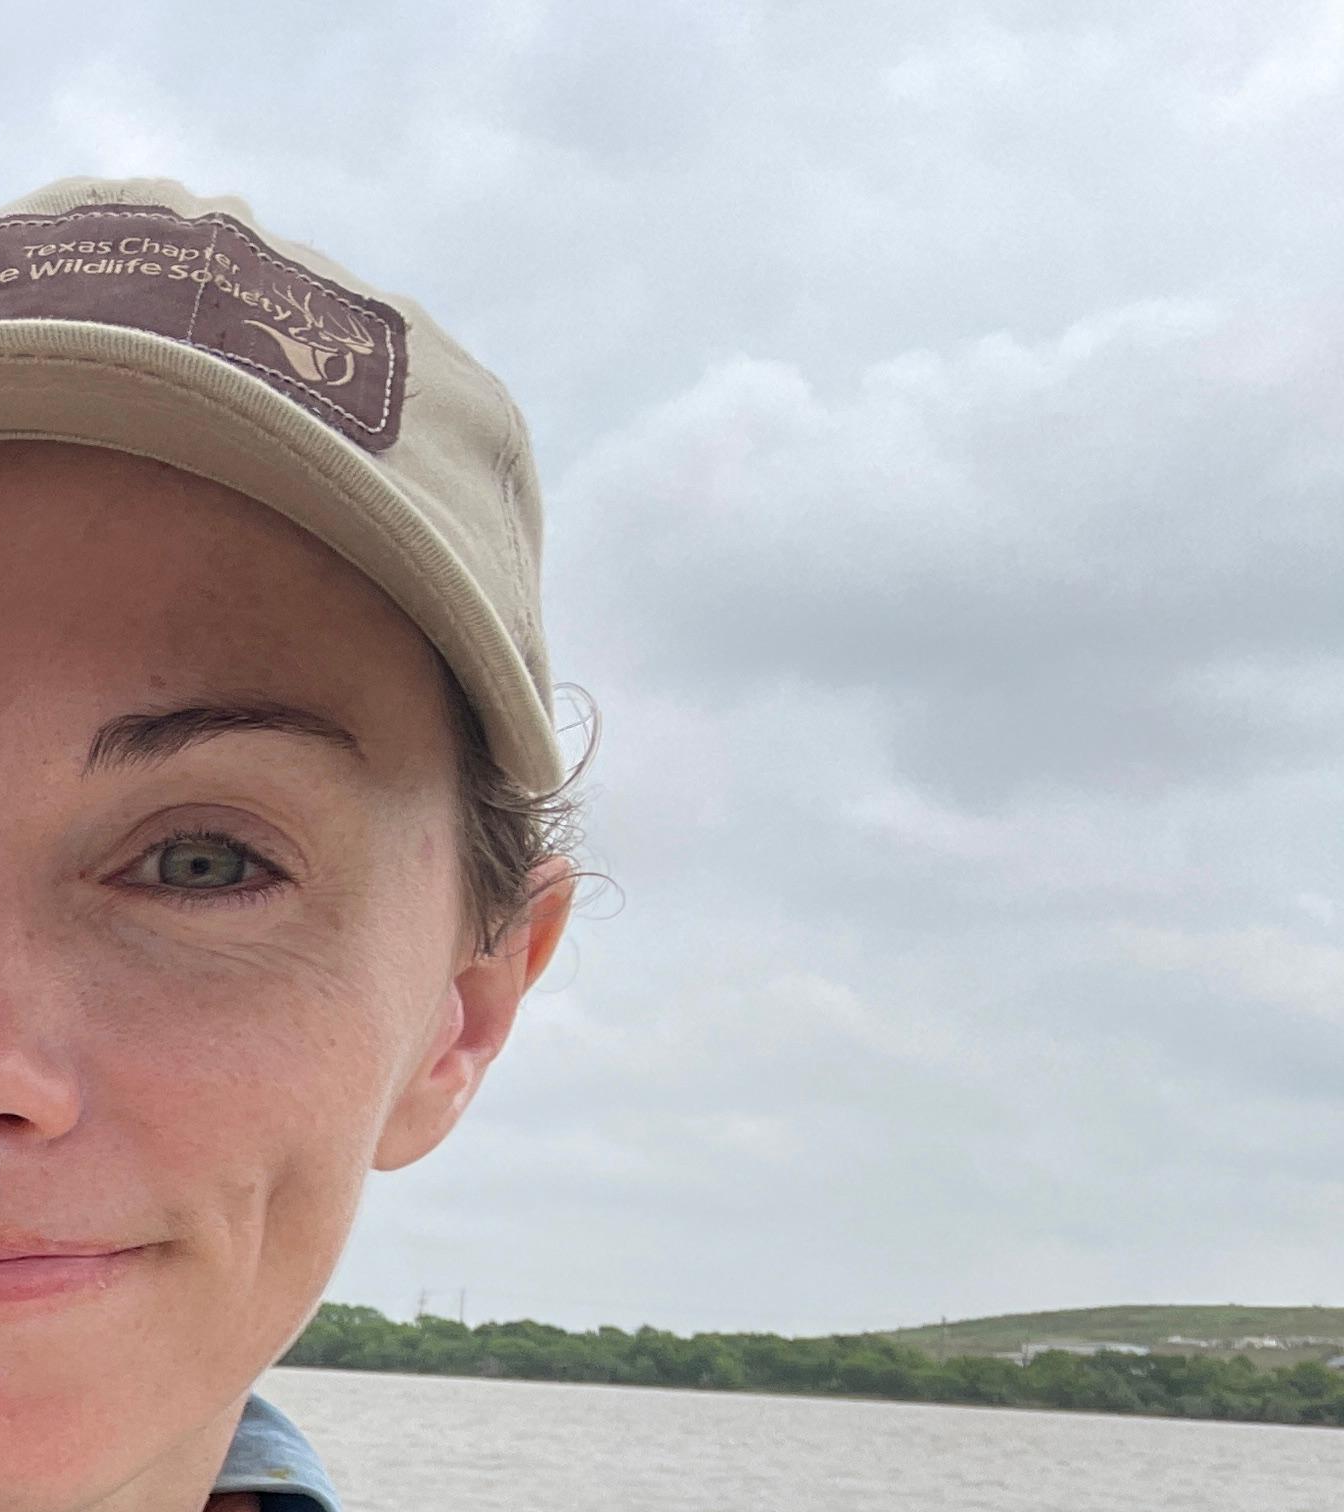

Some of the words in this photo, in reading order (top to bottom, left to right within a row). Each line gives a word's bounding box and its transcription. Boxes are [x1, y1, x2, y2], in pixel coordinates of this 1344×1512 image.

[24, 237, 113, 259] Texas
[119, 236, 241, 275] Chapter
[30, 255, 162, 282] Wildlife
